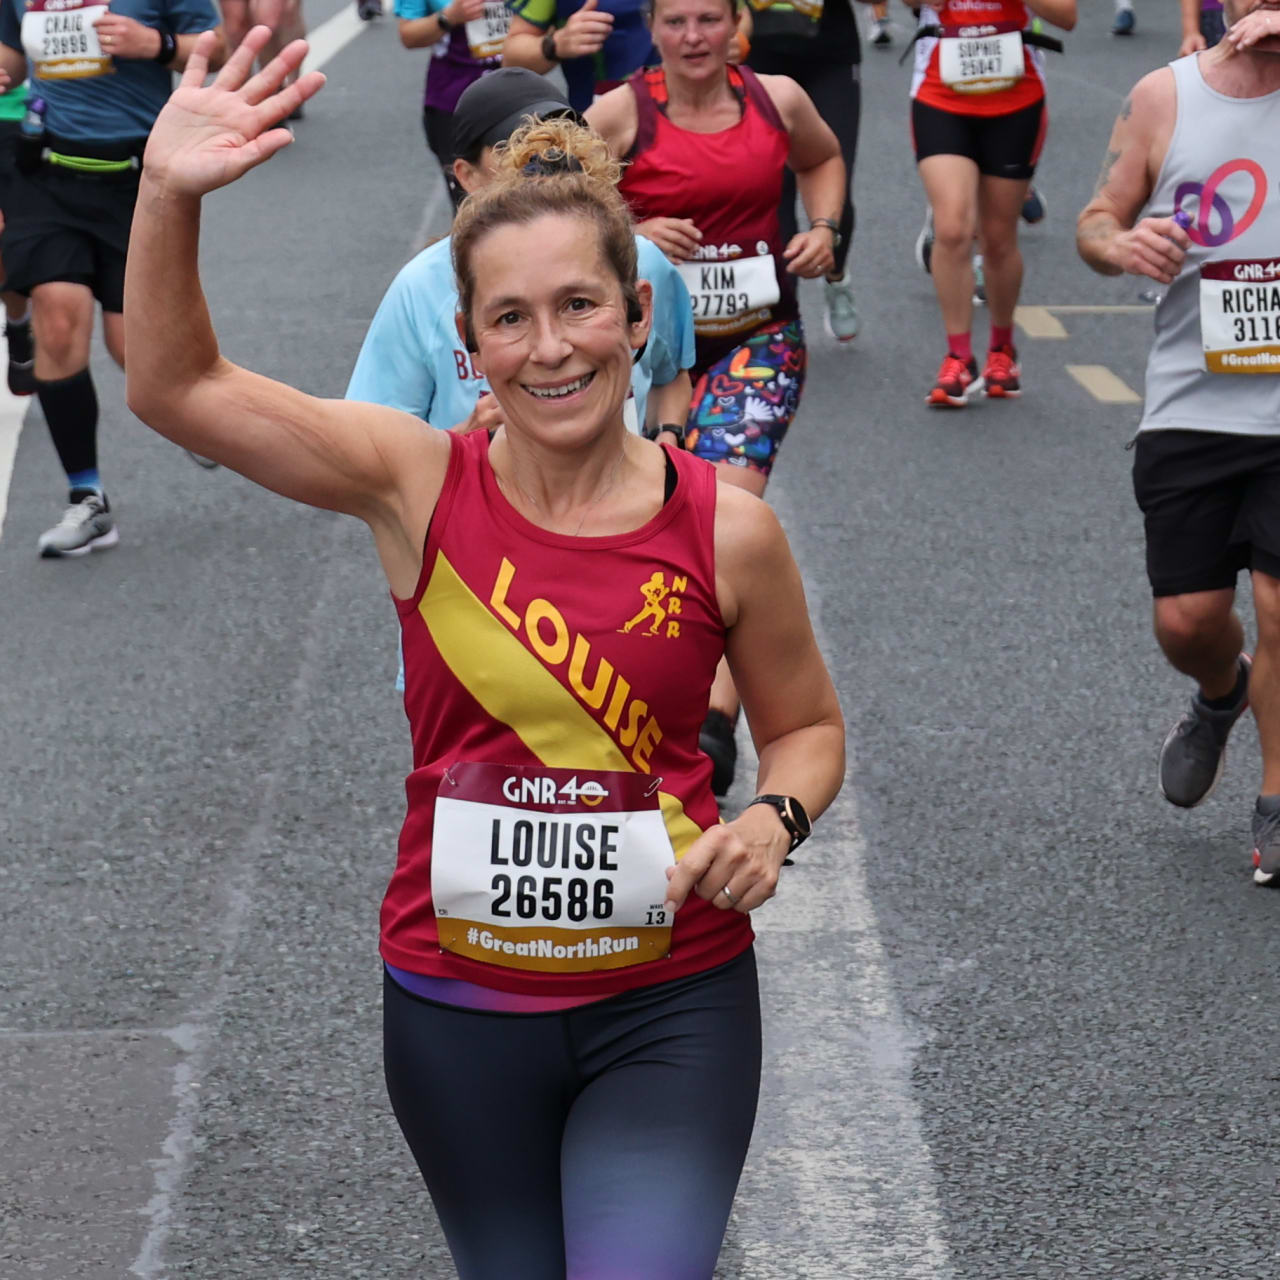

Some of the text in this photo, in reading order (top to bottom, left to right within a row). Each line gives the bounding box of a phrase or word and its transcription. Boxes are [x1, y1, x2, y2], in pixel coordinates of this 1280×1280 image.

[45, 15, 84, 34] CRAIG
[959, 40, 1001, 58] SOPHIE
[701, 267, 735, 290] KIM
[489, 556, 663, 774] LOUISE
[490, 818, 619, 871] LOUISE
[490, 873, 614, 922] 26586
[644, 911, 666, 926] 13
[466, 927, 639, 959] #GreatNorthRun
